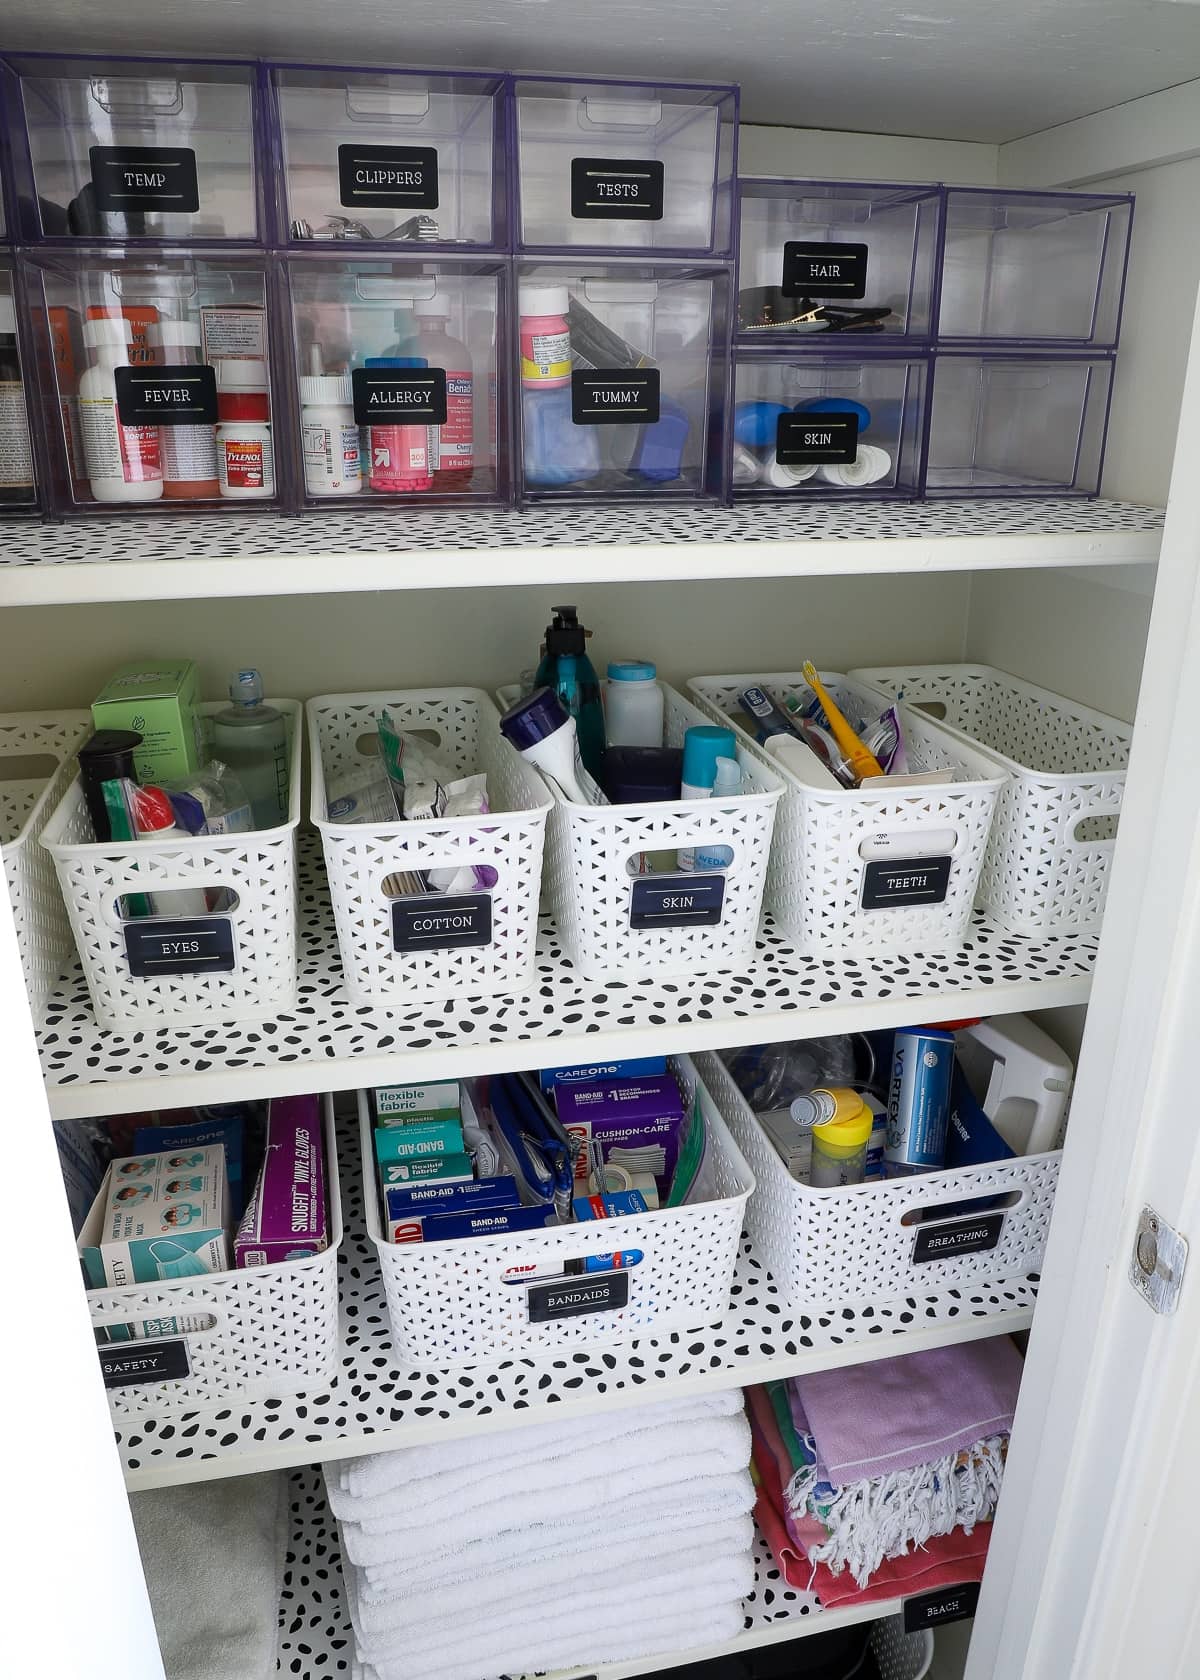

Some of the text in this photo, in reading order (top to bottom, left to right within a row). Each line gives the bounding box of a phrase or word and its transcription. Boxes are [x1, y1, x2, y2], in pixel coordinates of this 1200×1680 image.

[124, 172, 167, 187] TEMP
[355, 169, 423, 186] CLIPPERS
[597, 183, 639, 198] TESTS
[809, 264, 841, 278] HAIR
[144, 389, 192, 402] FEVER
[369, 391, 432, 403] ALLERGY
[592, 391, 640, 403] TUMMY
[804, 433, 832, 445] SKIN
[227, 452, 261, 461] TYLENOL
[887, 876, 927, 889] TEETH
[662, 896, 694, 909] SKIN
[413, 916, 473, 931] COTTON
[161, 941, 200, 954] EYES
[889, 1049, 905, 1124] VORTEX
[380, 1090, 425, 1101] flexible
[574, 1091, 603, 1100] BAND-AID
[380, 1100, 416, 1111] fabric
[595, 1124, 671, 1139] CUSHION-CARE
[295, 1127, 310, 1159] GLOVES
[294, 1159, 309, 1184] VINYL
[410, 1187, 454, 1200] BAND-AID
[471, 1216, 508, 1228] BAND-AID
[927, 1229, 989, 1249] BREATHING
[111, 1259, 127, 1286] FETY
[547, 1289, 610, 1306] BANDAIDS
[104, 1358, 158, 1374] SAFETY
[927, 1601, 960, 1617] BEACH
